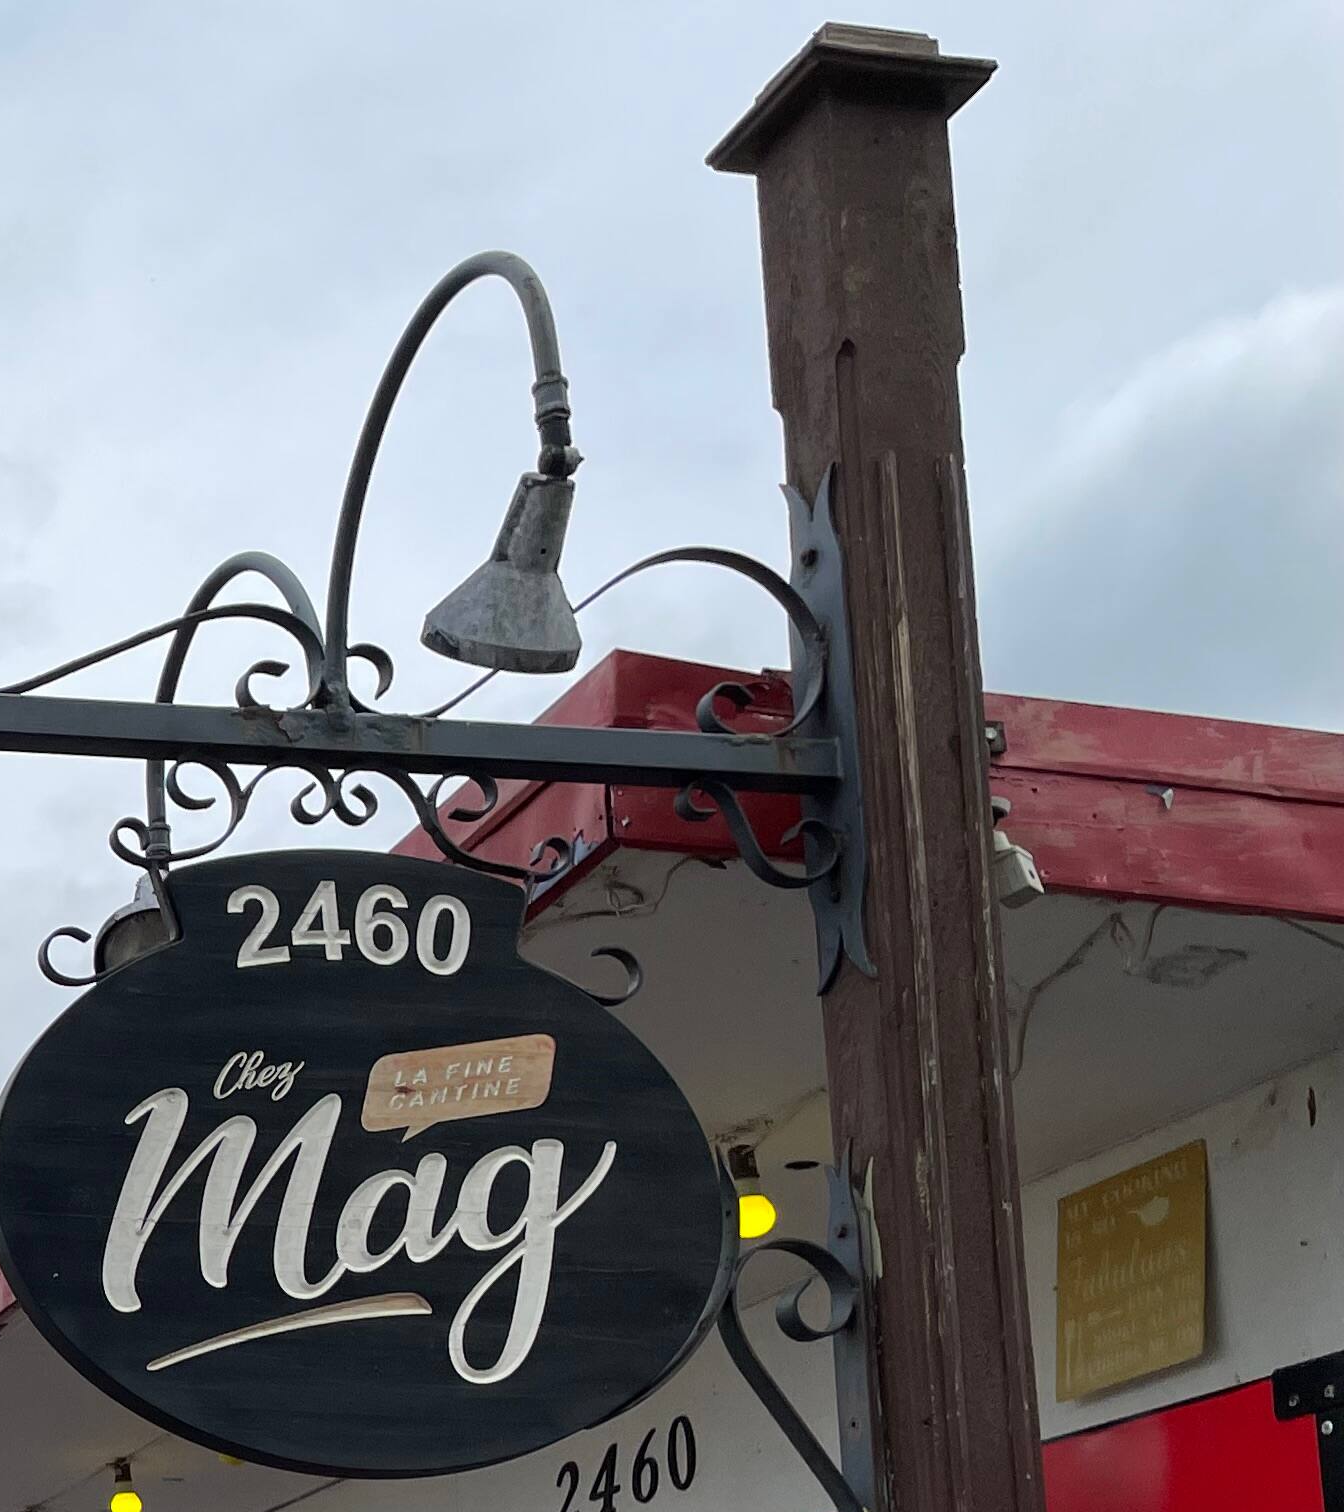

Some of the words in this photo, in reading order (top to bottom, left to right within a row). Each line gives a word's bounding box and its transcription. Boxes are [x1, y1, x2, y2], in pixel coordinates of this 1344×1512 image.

[226, 880, 472, 976] 2460
[213, 1050, 305, 1102] Chez
[390, 1078, 521, 1110] CANTINE
[394, 1068, 428, 1087] LA
[445, 1056, 513, 1080] FINE
[101, 1086, 616, 1385] Mag
